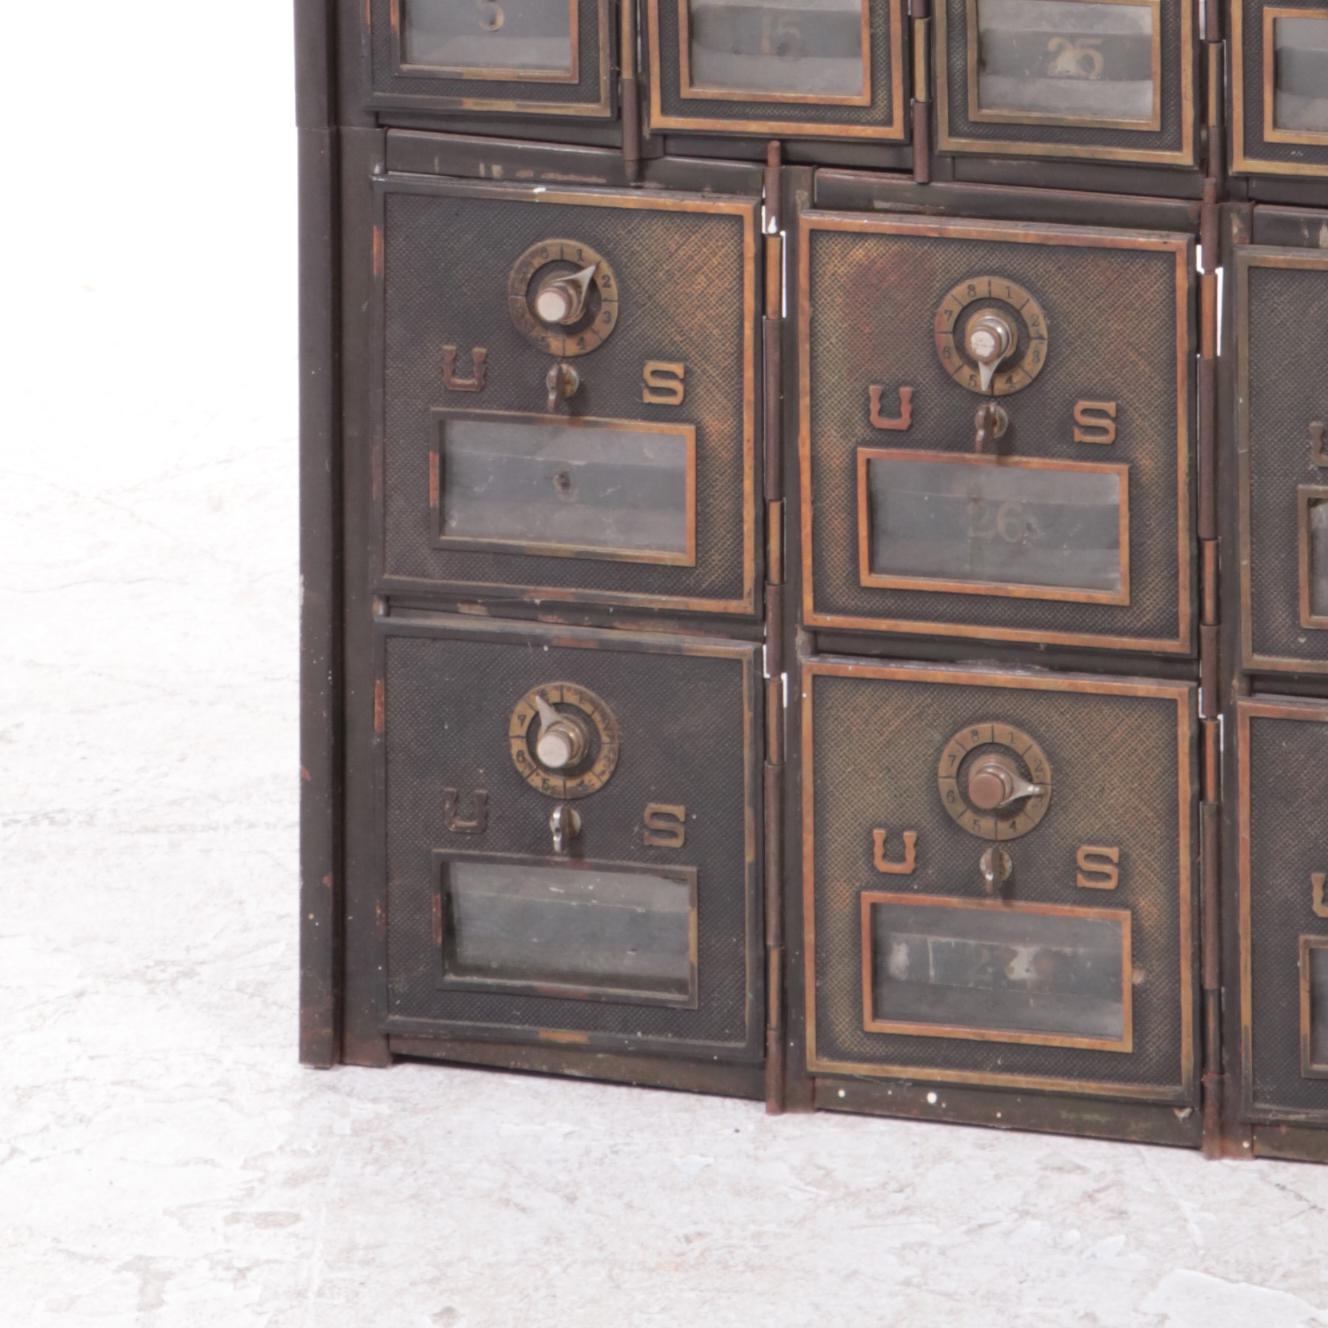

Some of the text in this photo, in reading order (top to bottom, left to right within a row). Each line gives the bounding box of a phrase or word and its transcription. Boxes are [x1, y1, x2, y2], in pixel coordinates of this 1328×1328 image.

[1047, 37, 1104, 79] 25
[441, 344, 686, 405] U S
[869, 385, 1116, 444] U S
[442, 786, 686, 848] U S
[873, 828, 1119, 889] U S
